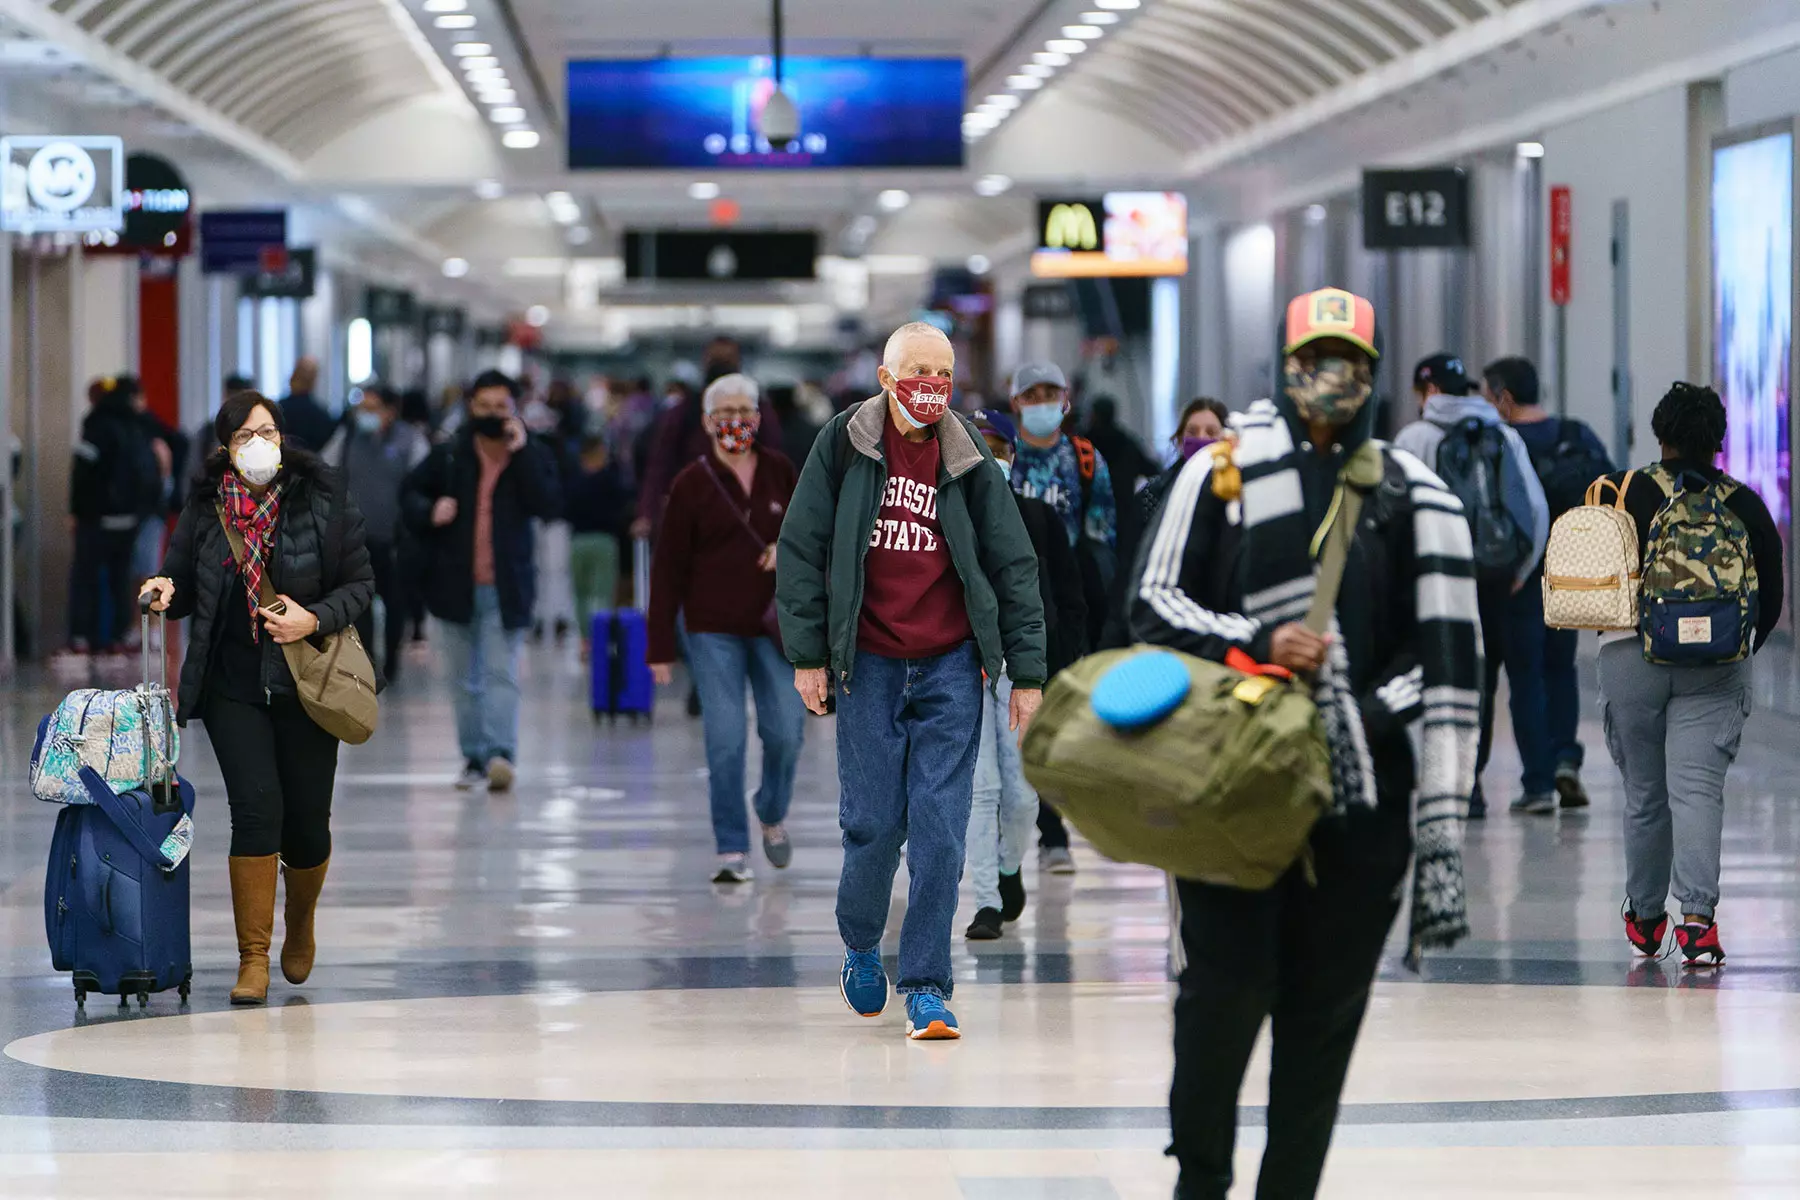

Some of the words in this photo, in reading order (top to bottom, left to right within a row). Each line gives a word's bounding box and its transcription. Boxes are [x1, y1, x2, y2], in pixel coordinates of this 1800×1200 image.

[1385, 190, 1446, 226] E12
[919, 394, 944, 403] STATE
[869, 519, 937, 551] STATE
